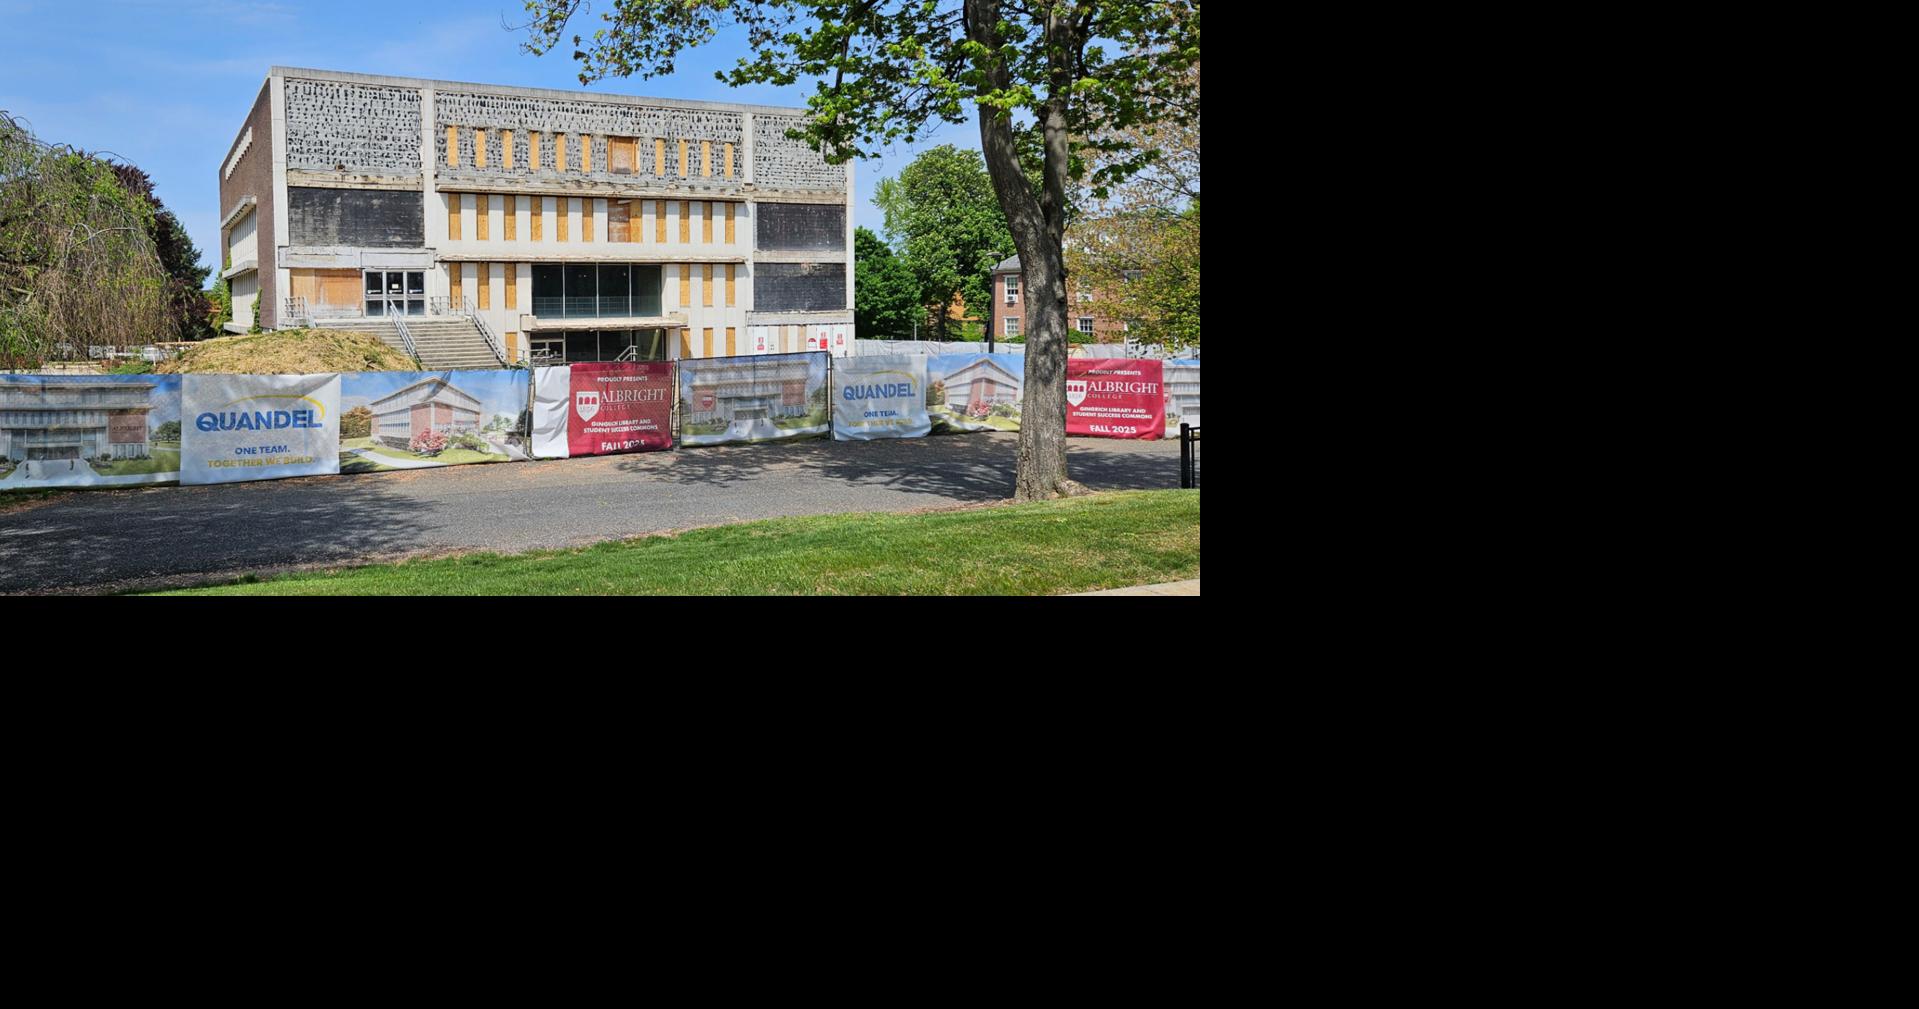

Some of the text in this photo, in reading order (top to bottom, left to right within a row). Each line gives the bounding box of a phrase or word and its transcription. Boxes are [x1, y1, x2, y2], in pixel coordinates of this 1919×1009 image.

[843, 383, 916, 400] QUANDEL
[1088, 381, 1158, 394] ALBRIGHT
[601, 388, 666, 403] ALBRIGHT
[196, 410, 322, 432] QUANDEL
[1112, 426, 1136, 434] 2025
[235, 445, 290, 455] ONE TEAM.
[601, 441, 620, 451] FALL
[208, 458, 262, 468] TOGETHER
[266, 457, 281, 466] WE
